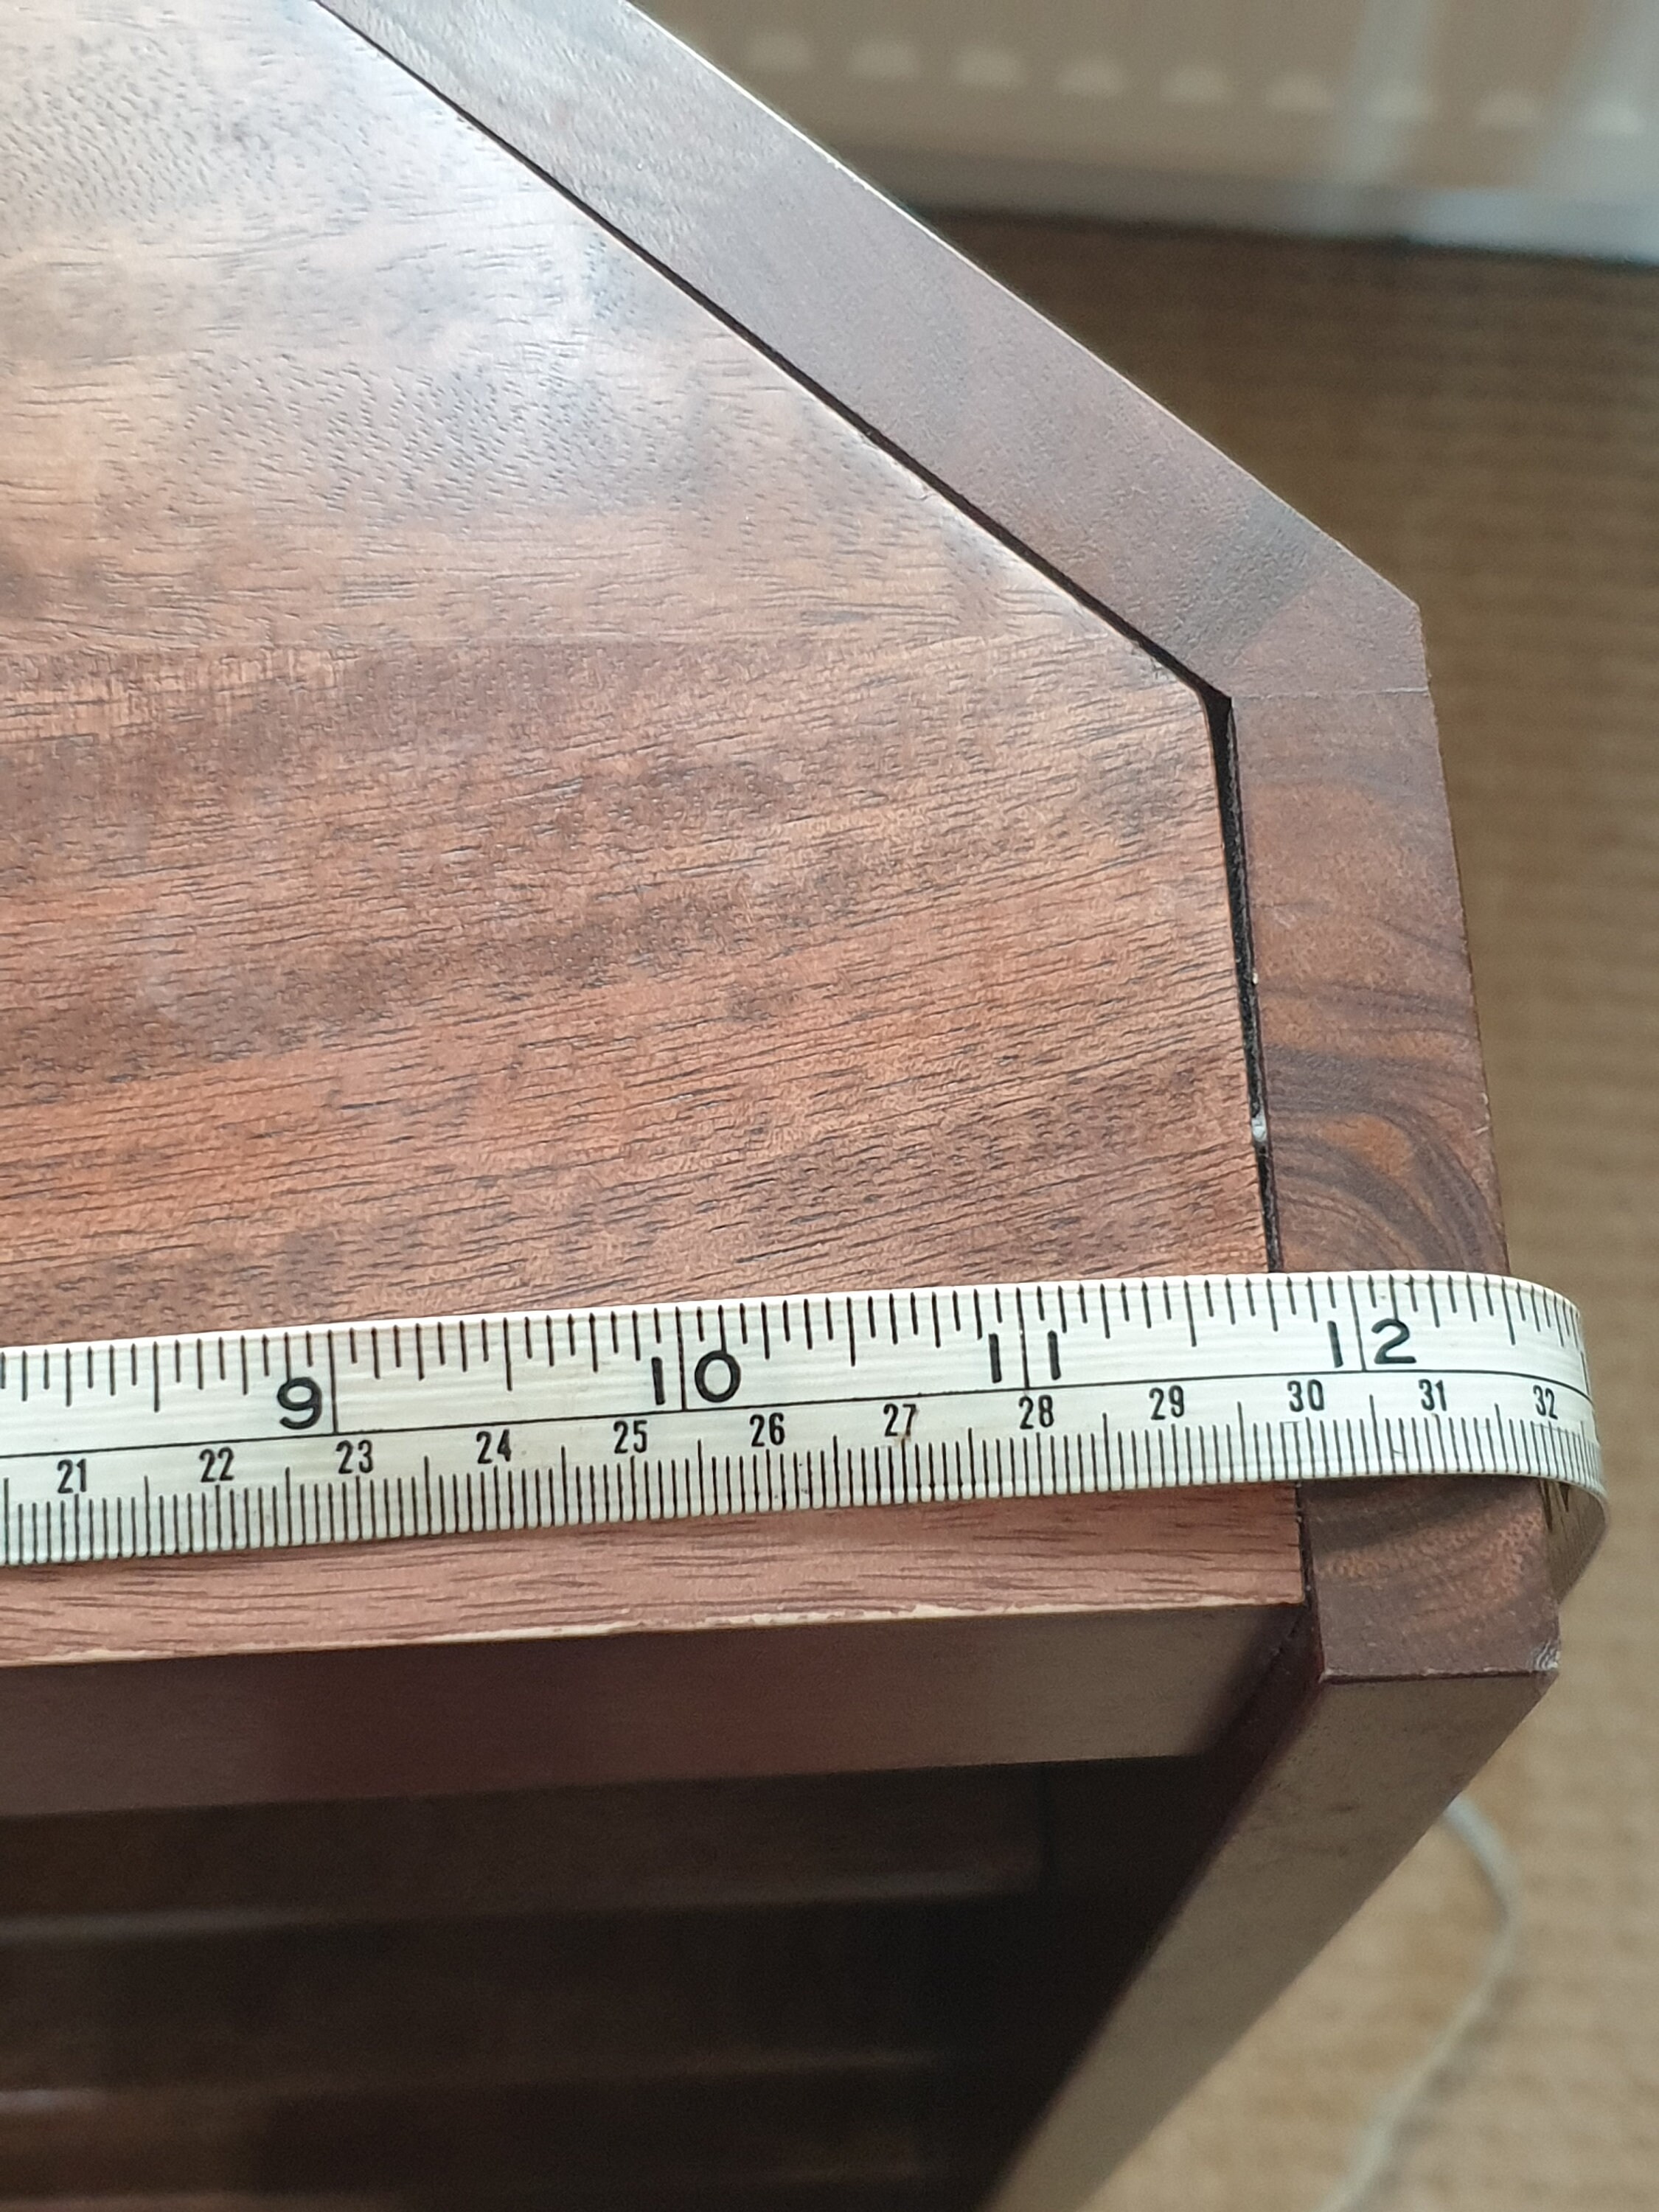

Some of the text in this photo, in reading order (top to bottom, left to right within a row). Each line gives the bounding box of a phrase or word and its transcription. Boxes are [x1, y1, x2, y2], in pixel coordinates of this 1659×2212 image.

[58, 1379, 1559, 1495] 21 22 23 24 25 26 27 28 29 30 31 32
[276, 1377, 323, 1430] 9
